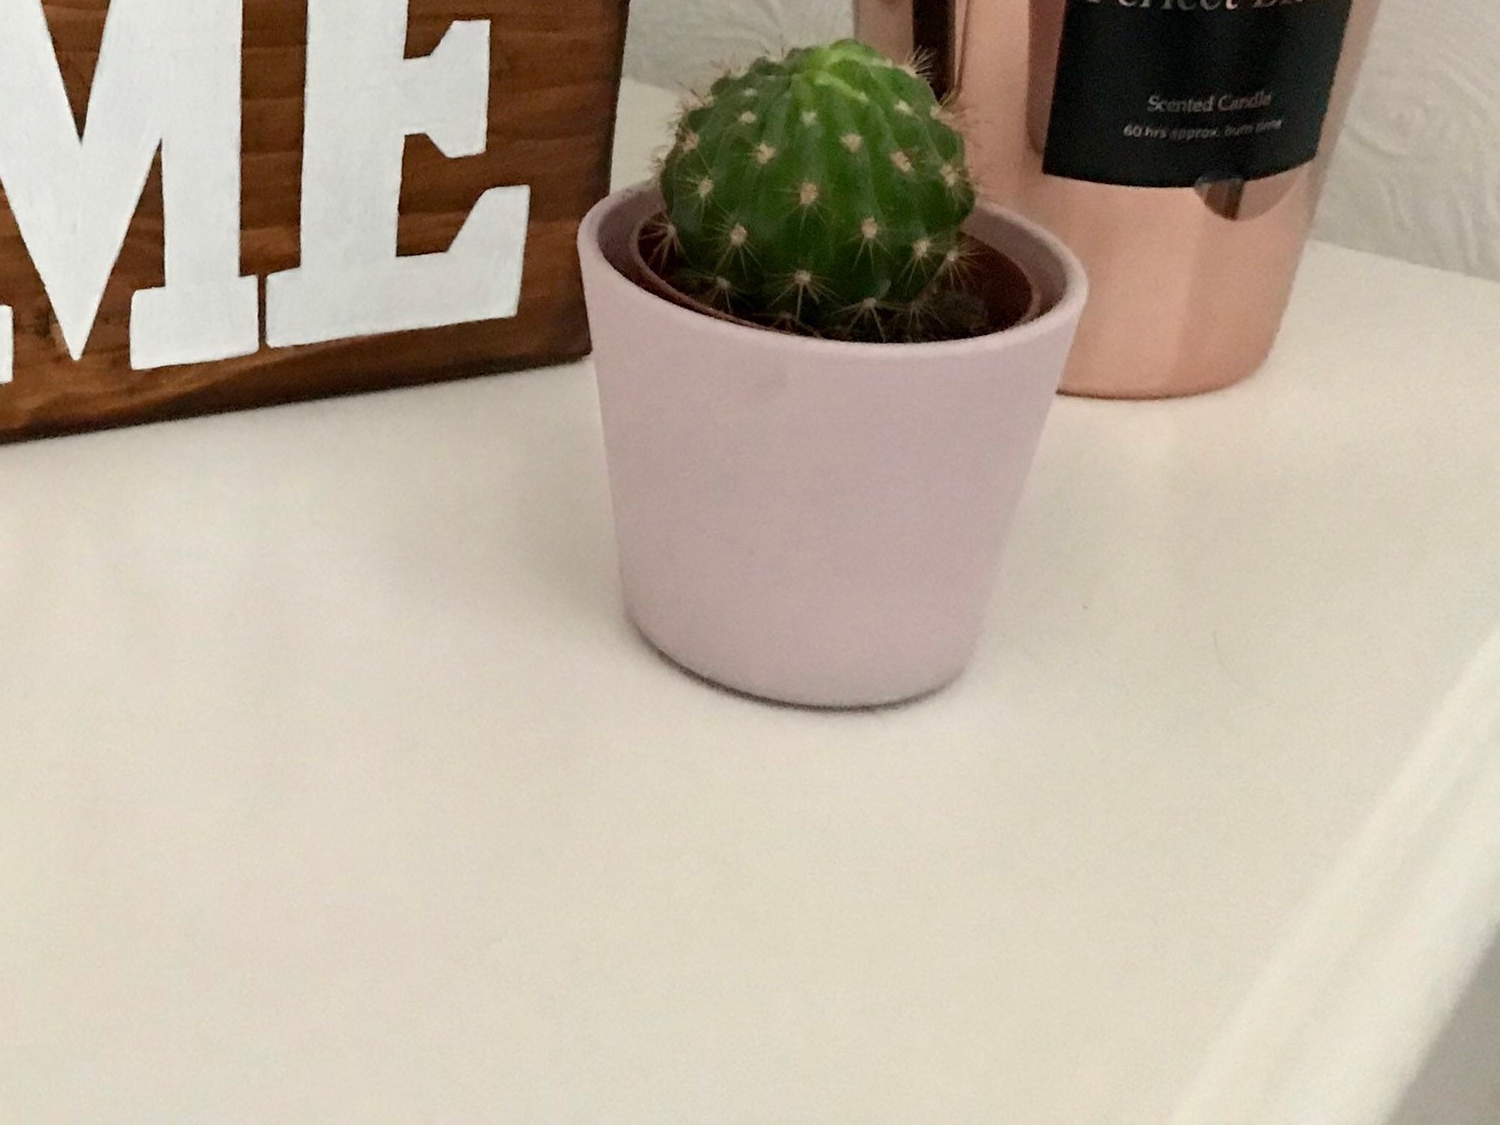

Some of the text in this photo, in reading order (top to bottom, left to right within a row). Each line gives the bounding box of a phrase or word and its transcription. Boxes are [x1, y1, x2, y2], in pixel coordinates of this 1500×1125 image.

[1147, 90, 1272, 113] Scented Candle
[1123, 125, 1142, 137] 60
[1144, 125, 1167, 139] hrs
